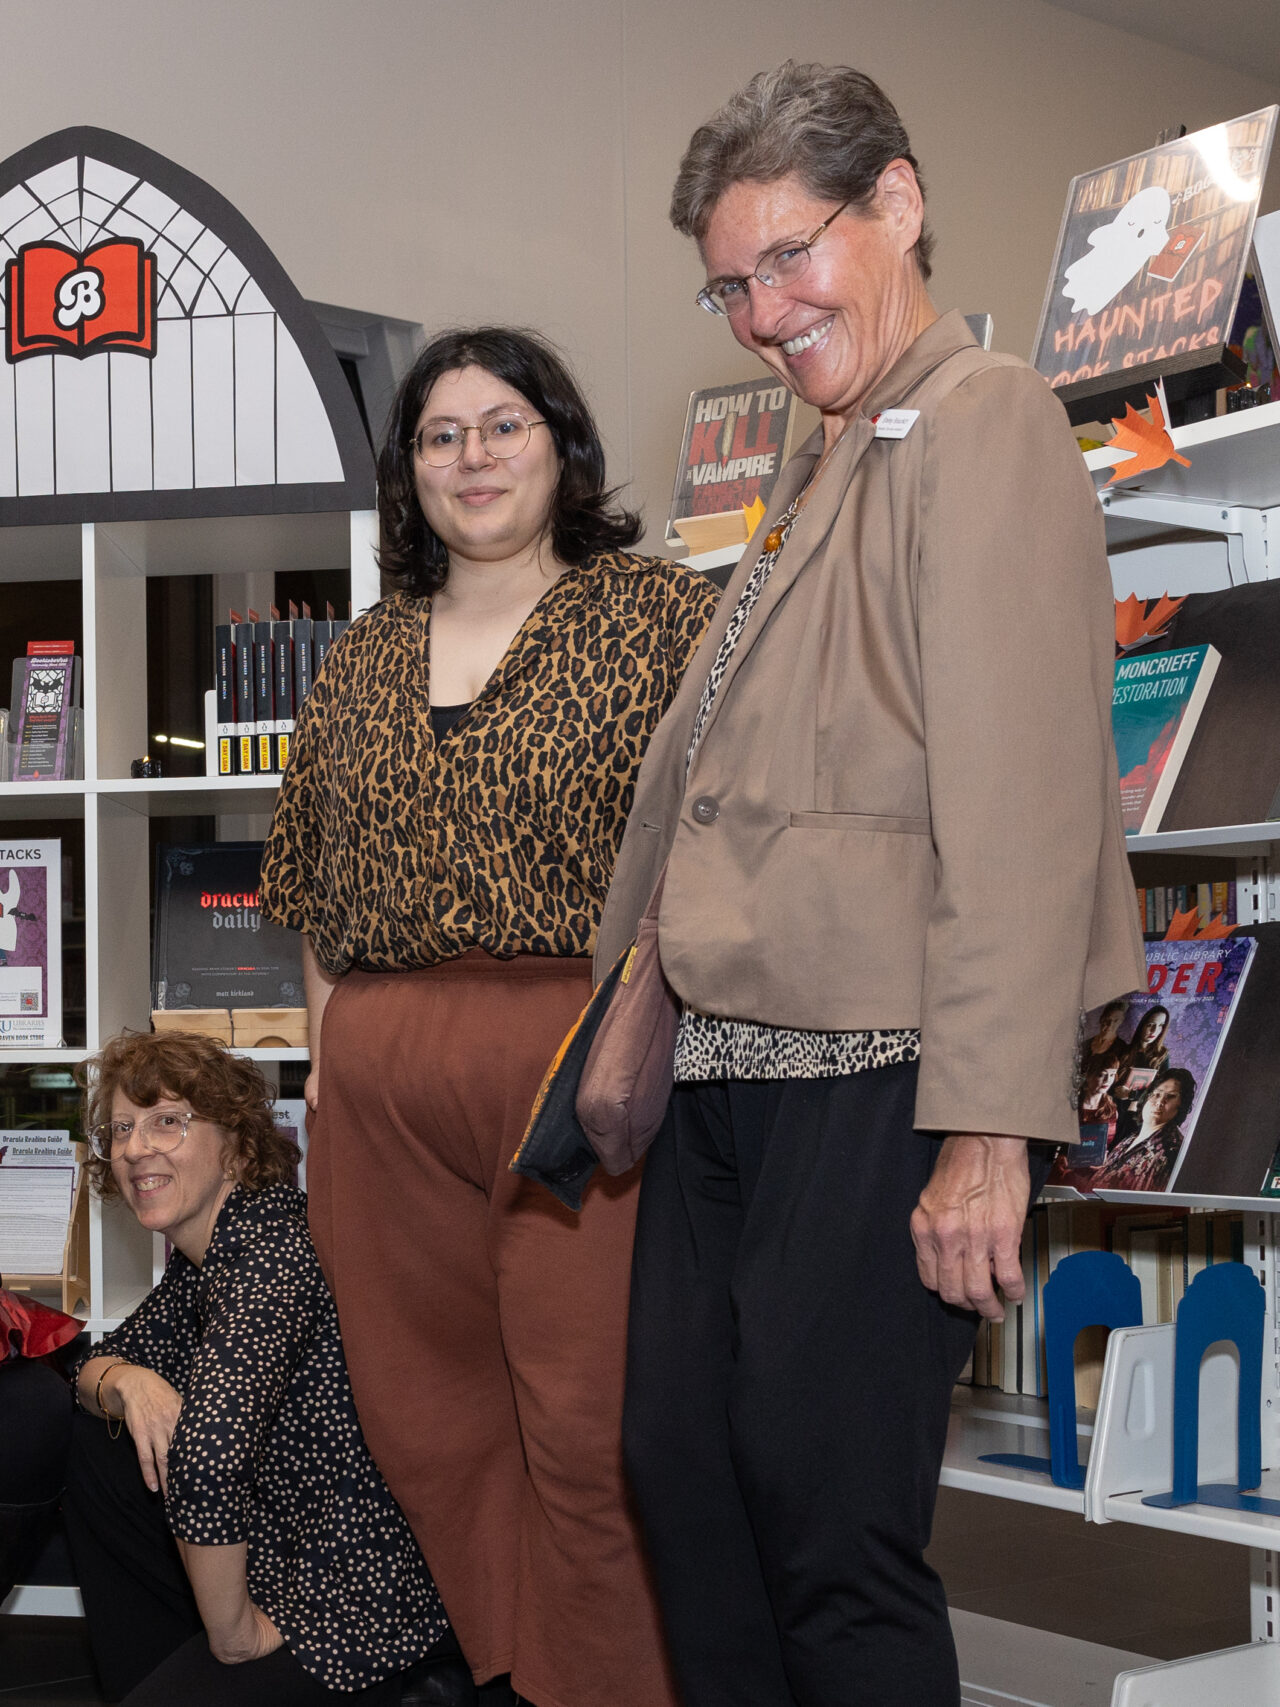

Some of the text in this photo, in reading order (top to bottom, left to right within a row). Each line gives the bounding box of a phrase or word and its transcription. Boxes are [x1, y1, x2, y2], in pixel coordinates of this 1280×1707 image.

[1054, 278, 1223, 358] HAUNTED
[1044, 326, 1219, 388] OOK STACKS
[694, 386, 787, 424] HOW TO
[688, 412, 778, 465] KILL
[692, 452, 777, 485] VAMPIRE
[1116, 651, 1199, 681] MONCRIEFF
[212, 908, 261, 932] daily
[1145, 949, 1232, 961] UBLIC LIBRARY
[1145, 962, 1223, 994] DER
[271, 1110, 290, 1119] est
[34, 1148, 57, 1156] Reading
